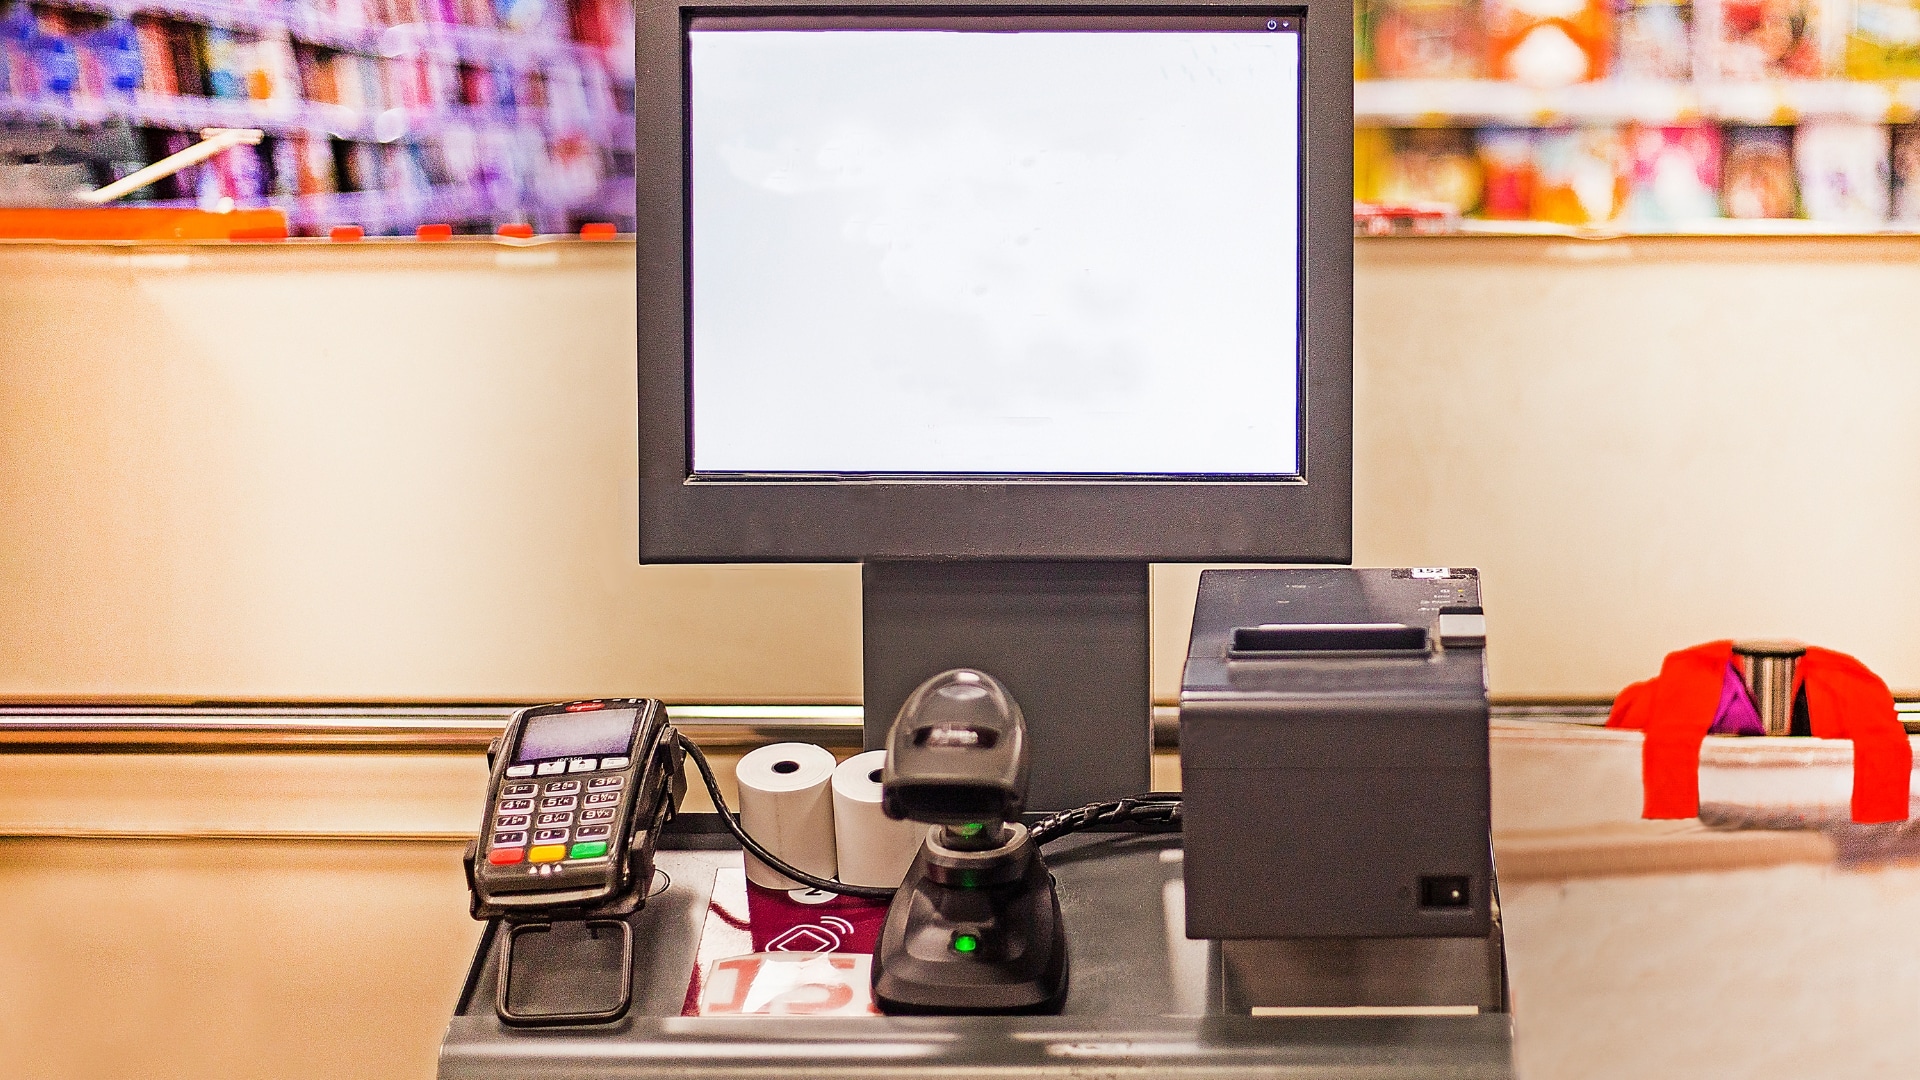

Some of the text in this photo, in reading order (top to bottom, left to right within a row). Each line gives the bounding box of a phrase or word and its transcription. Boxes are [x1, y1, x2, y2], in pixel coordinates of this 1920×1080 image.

[551, 782, 561, 791] 2
[595, 778, 605, 786] 3
[546, 797, 557, 806] 5
[590, 794, 600, 802] 6
[503, 800, 514, 809] 4
[542, 814, 553, 823] 8
[585, 810, 596, 819] 9
[501, 817, 511, 826] 7
[540, 831, 551, 839] 0
